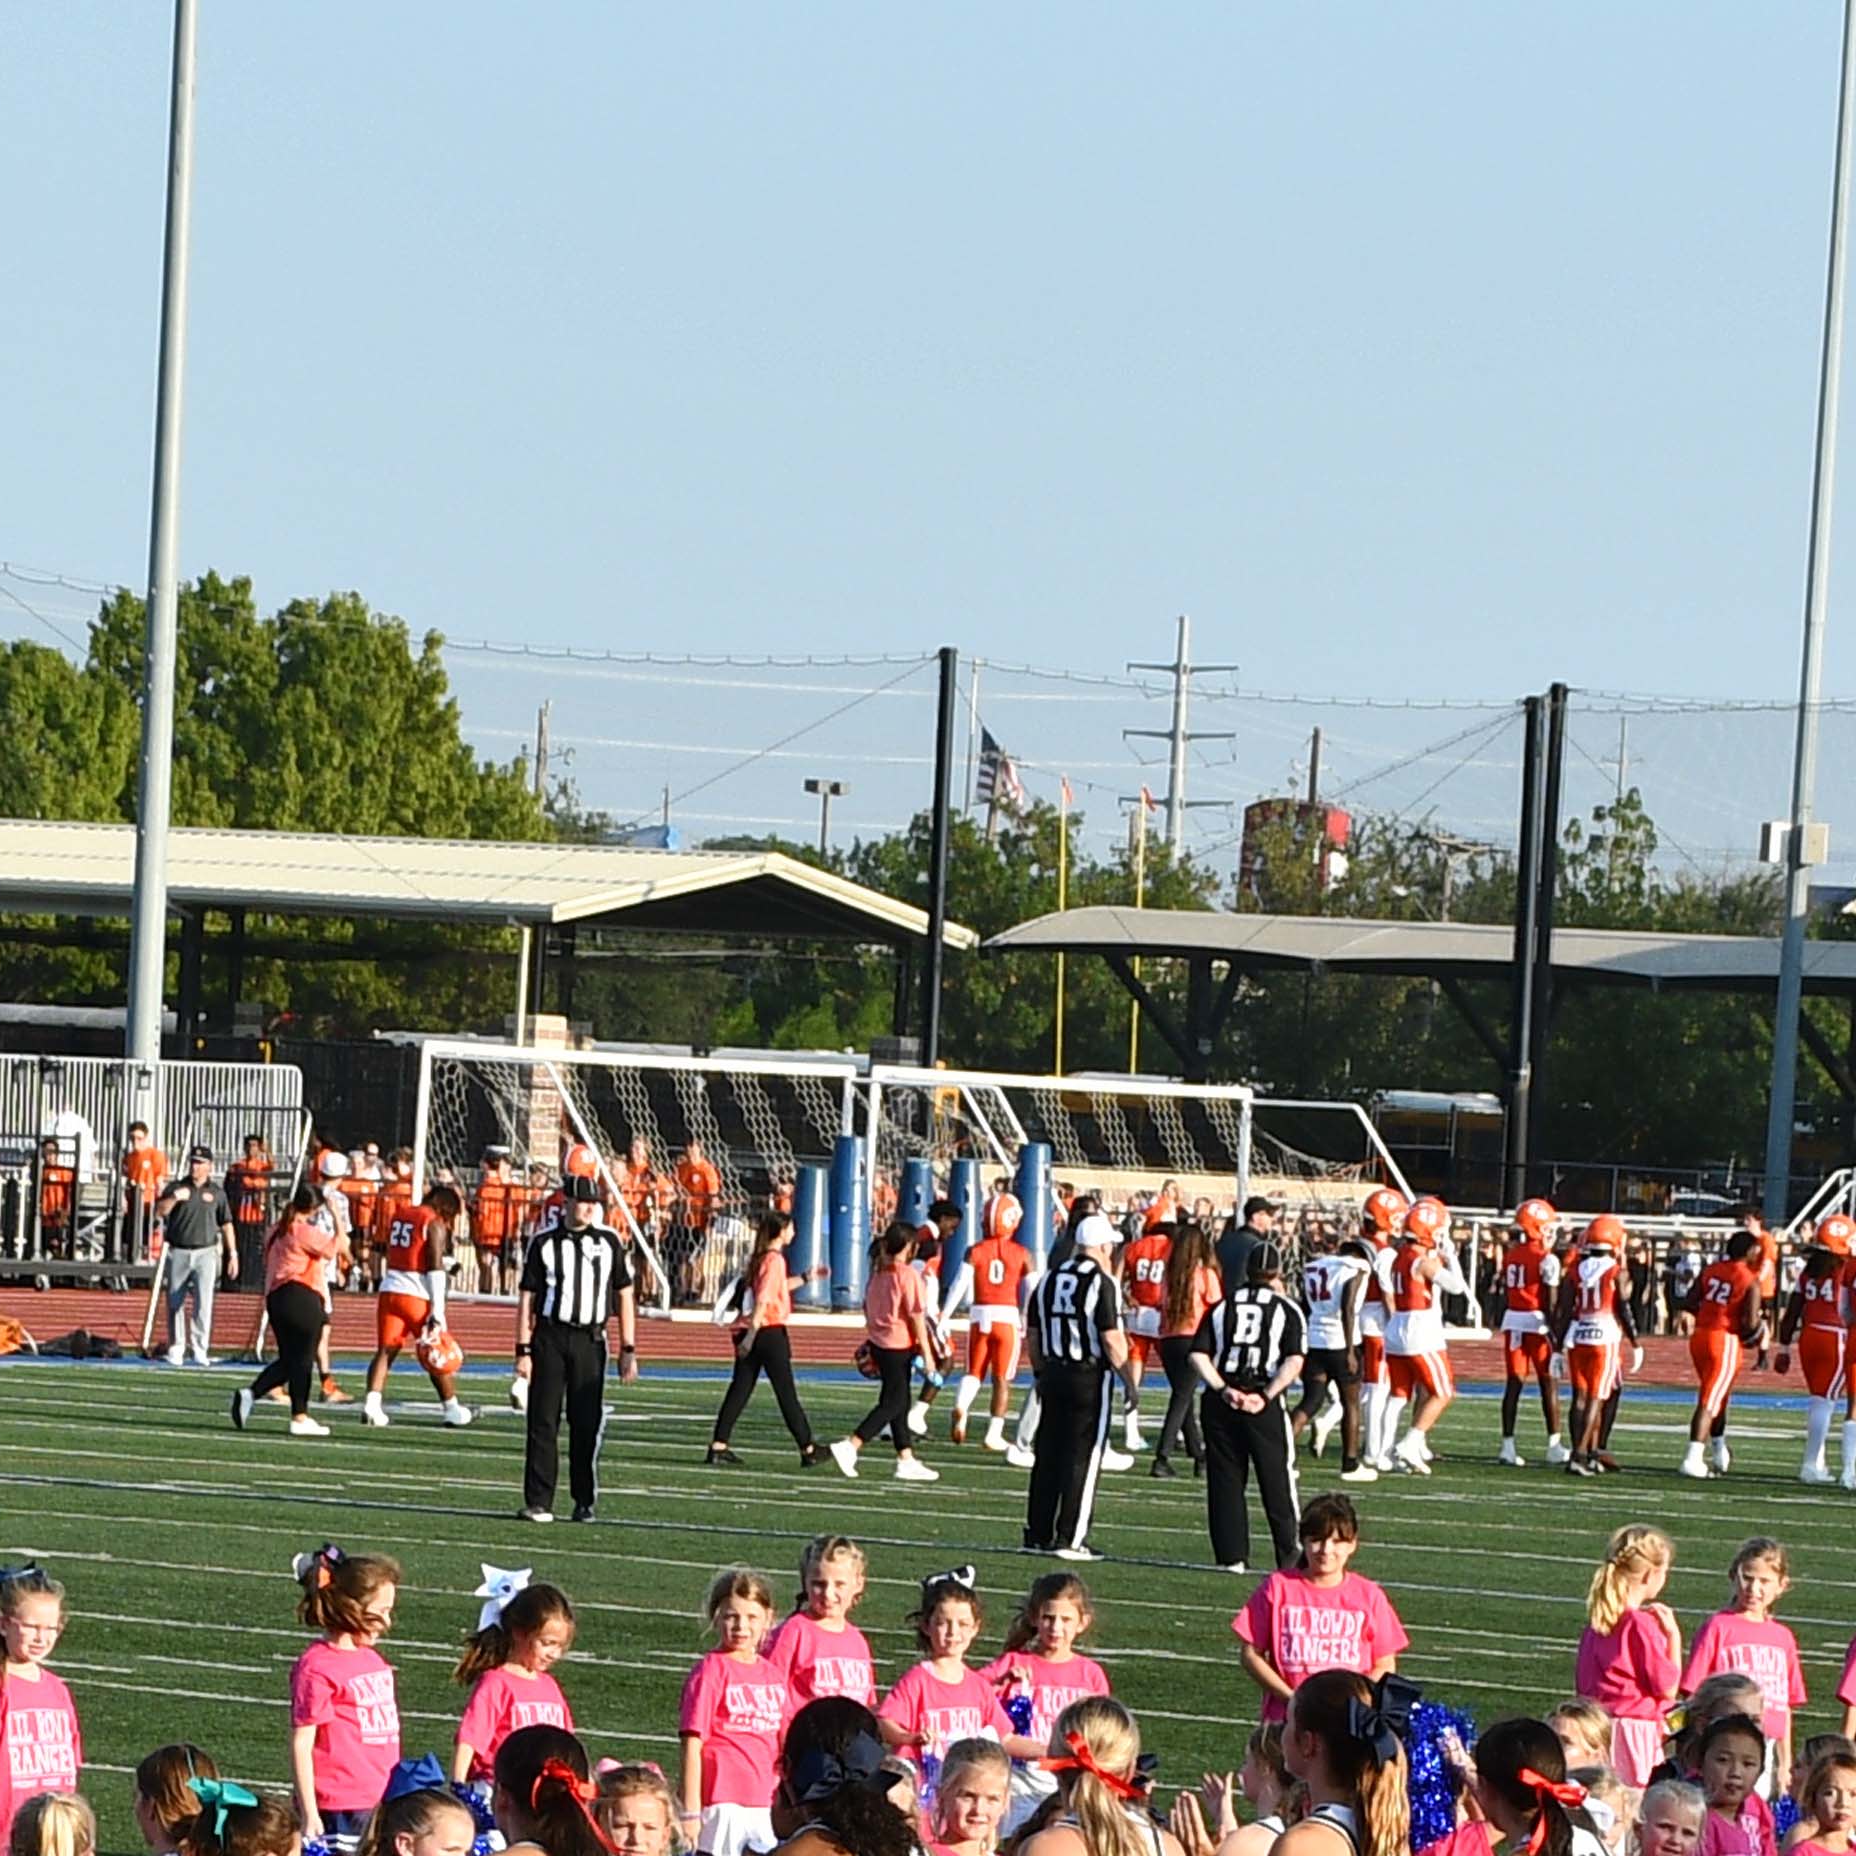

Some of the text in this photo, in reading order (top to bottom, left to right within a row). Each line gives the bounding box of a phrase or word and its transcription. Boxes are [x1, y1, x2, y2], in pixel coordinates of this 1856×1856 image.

[390, 1221, 413, 1248] 25
[988, 1259, 1004, 1285] 0
[1507, 1263, 1525, 1289] 61
[1051, 1273, 1078, 1315] R
[1706, 1277, 1732, 1305] 72
[1805, 1279, 1834, 1303] 54
[1232, 1304, 1263, 1344] B
[1282, 1606, 1366, 1641] LIL ROWDY
[1281, 1636, 1362, 1666] RANGERS
